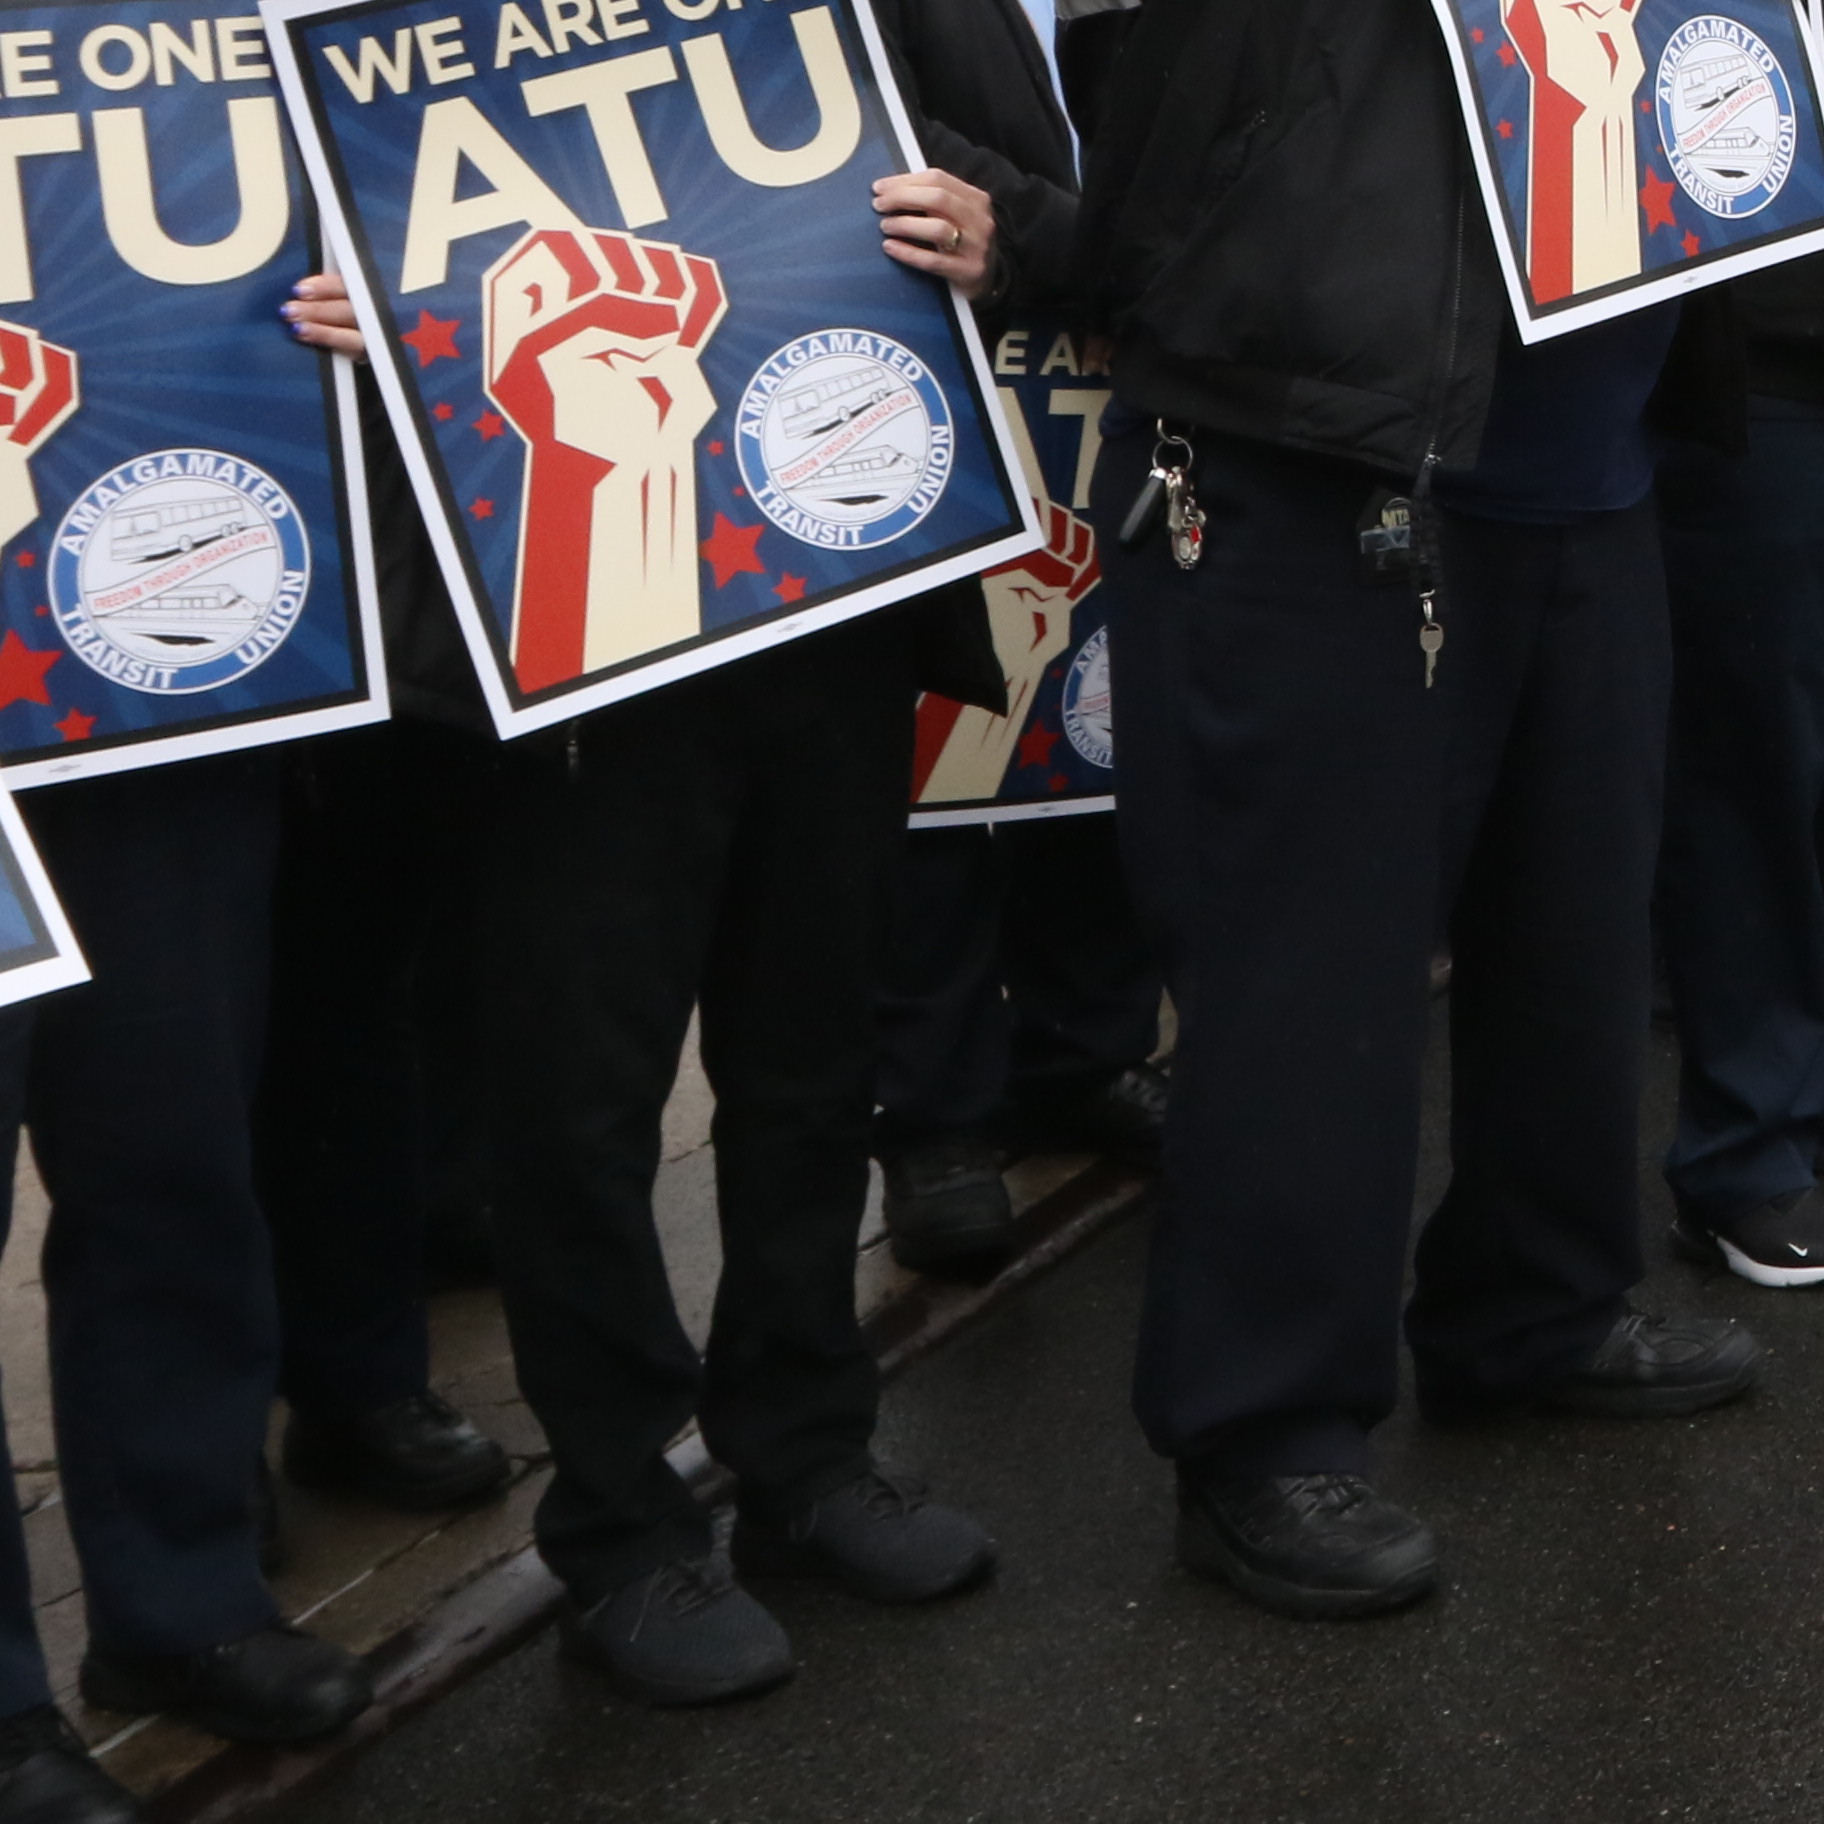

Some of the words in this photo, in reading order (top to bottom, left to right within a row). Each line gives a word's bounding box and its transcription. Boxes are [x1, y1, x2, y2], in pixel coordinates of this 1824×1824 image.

[79, 15, 271, 91] ONE
[323, 16, 474, 104] WE
[1659, 20, 1774, 104] AMALGAMATED
[400, 5, 862, 294] ATU
[1670, 144, 1734, 214] TRANSIT
[1762, 114, 1792, 194] UNION
[740, 332, 923, 440] AMALGAMATED
[780, 458, 818, 483] FREEDOM
[853, 393, 913, 436] ORGANIZATION
[905, 425, 950, 514] UNION
[61, 454, 288, 558] AMALGAMATED
[757, 479, 864, 545] TRANSIT
[94, 584, 142, 609] FREEDOM
[143, 564, 194, 592] THROUGH
[196, 531, 268, 568] ORGANIZATION
[61, 602, 178, 689] TRANSIT
[235, 570, 304, 665] UNION
